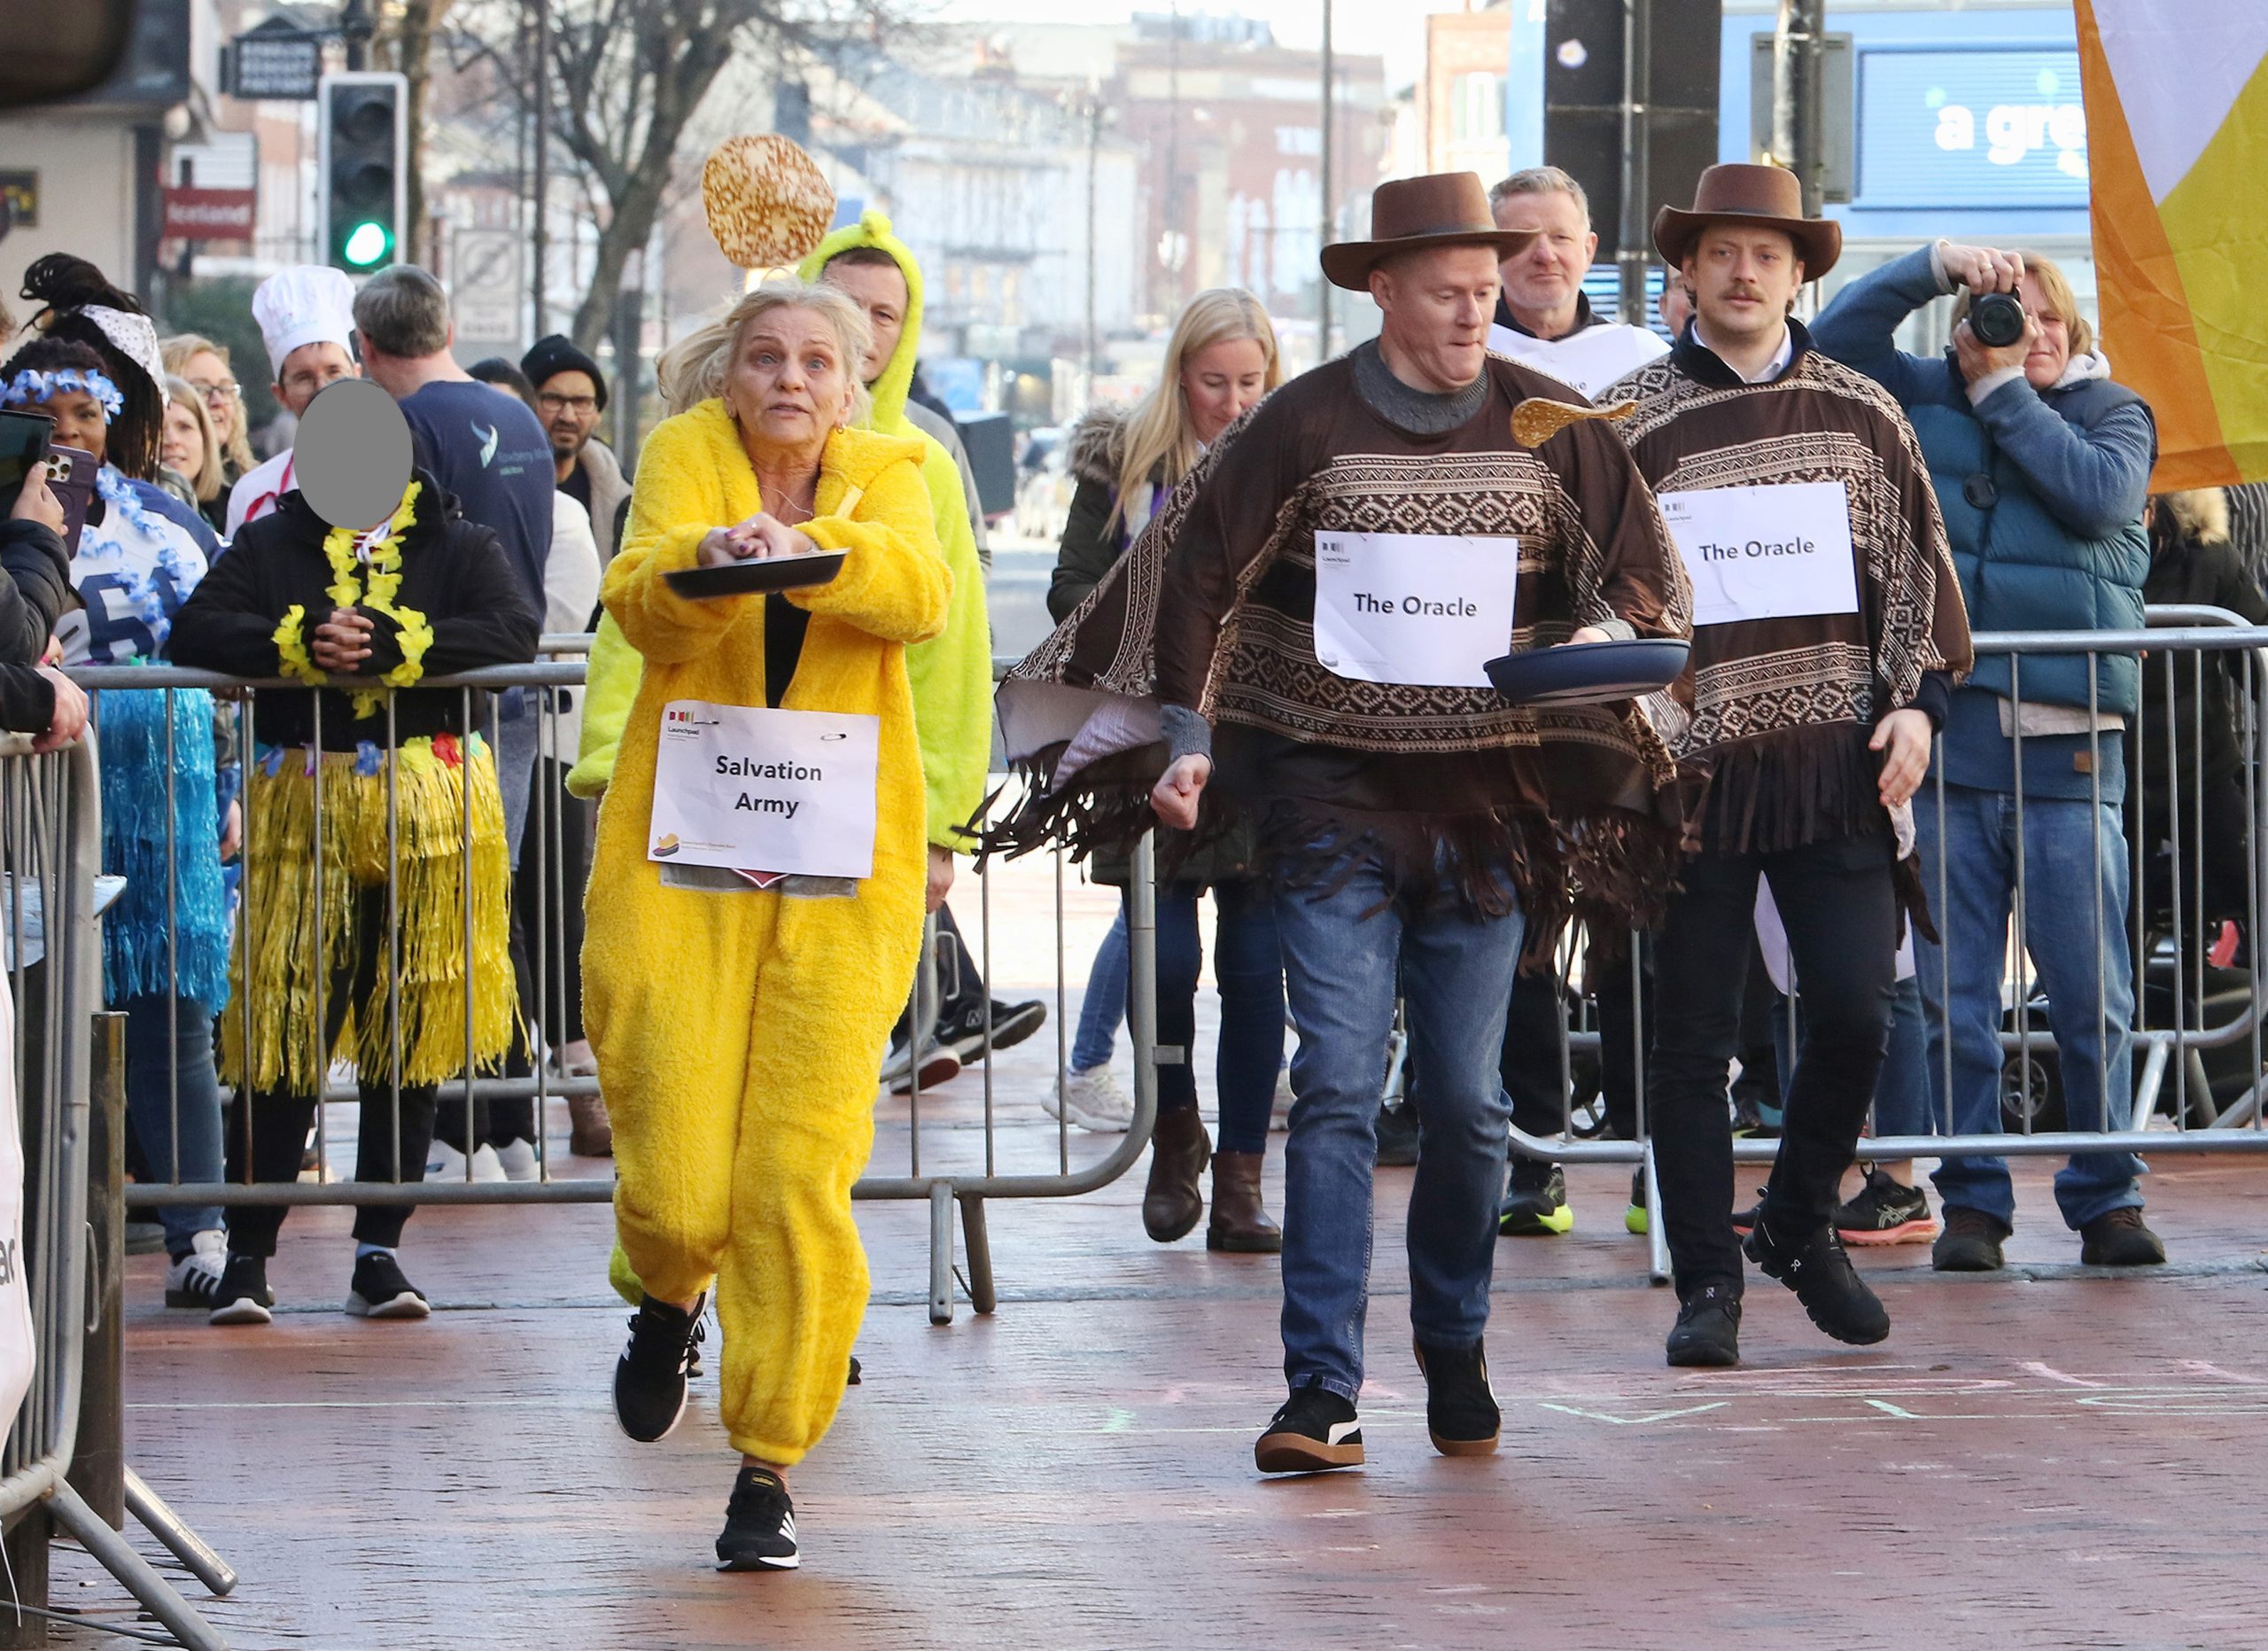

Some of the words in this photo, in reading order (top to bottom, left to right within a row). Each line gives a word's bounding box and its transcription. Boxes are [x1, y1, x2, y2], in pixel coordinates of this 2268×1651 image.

[1934, 105, 1974, 151] a
[1698, 543, 1738, 562] The
[1744, 536, 1815, 558] Oracle
[1353, 593, 1394, 614] The
[1402, 596, 1478, 617] Oracle
[715, 755, 822, 782] Salvation
[734, 792, 799, 820] Army
